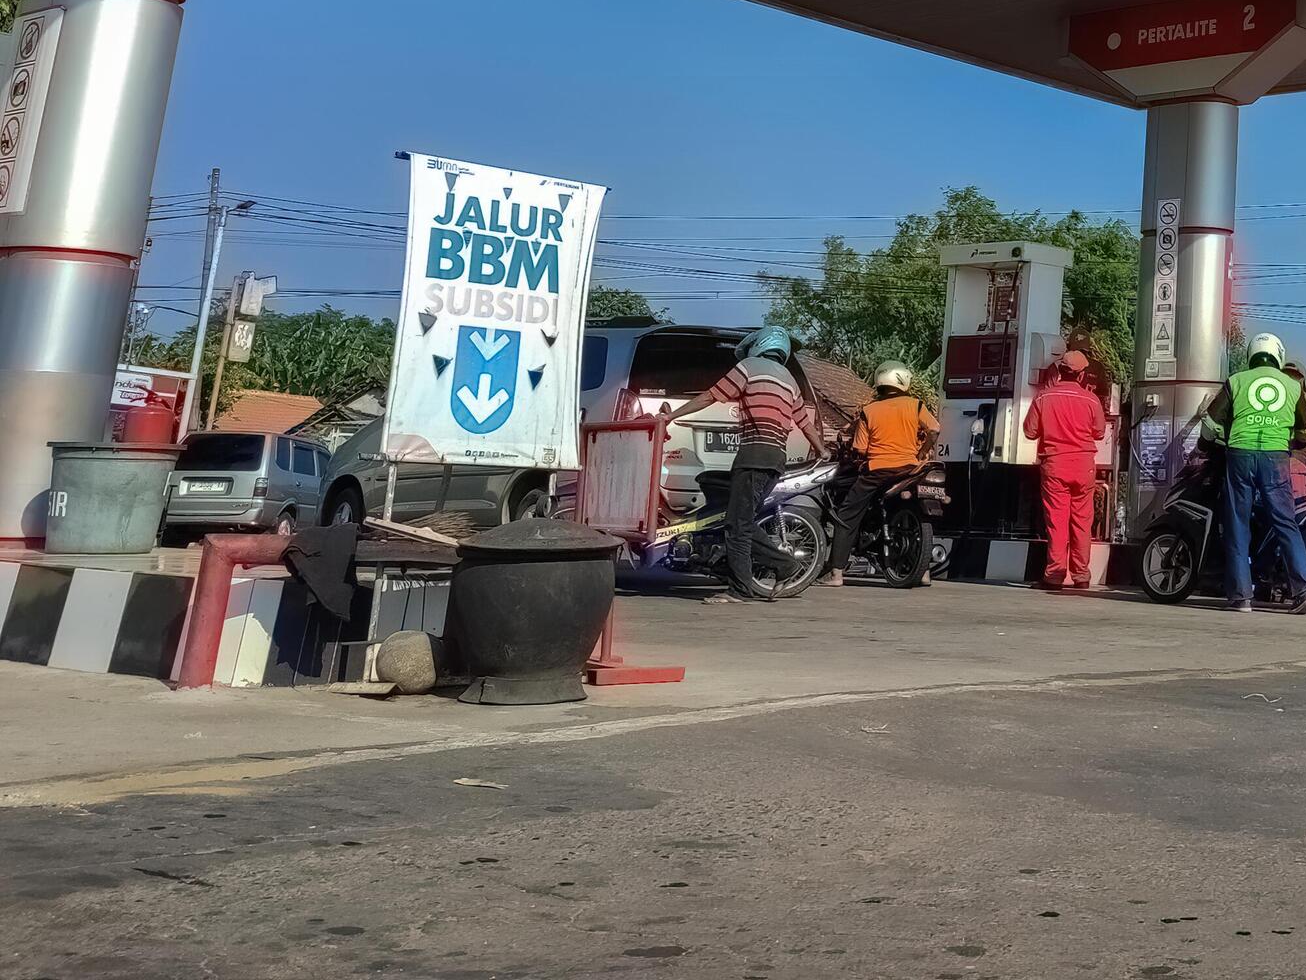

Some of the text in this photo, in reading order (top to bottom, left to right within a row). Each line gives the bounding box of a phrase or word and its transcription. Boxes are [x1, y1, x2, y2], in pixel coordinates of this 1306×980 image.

[1137, 4, 1256, 45] PERTALITE 2
[433, 191, 563, 242] JALUR
[425, 227, 559, 294] BBM
[425, 282, 559, 327] SUBSIDI
[706, 432, 713, 444] B
[1246, 414, 1280, 427] gojek
[937, 444, 950, 457] 2A
